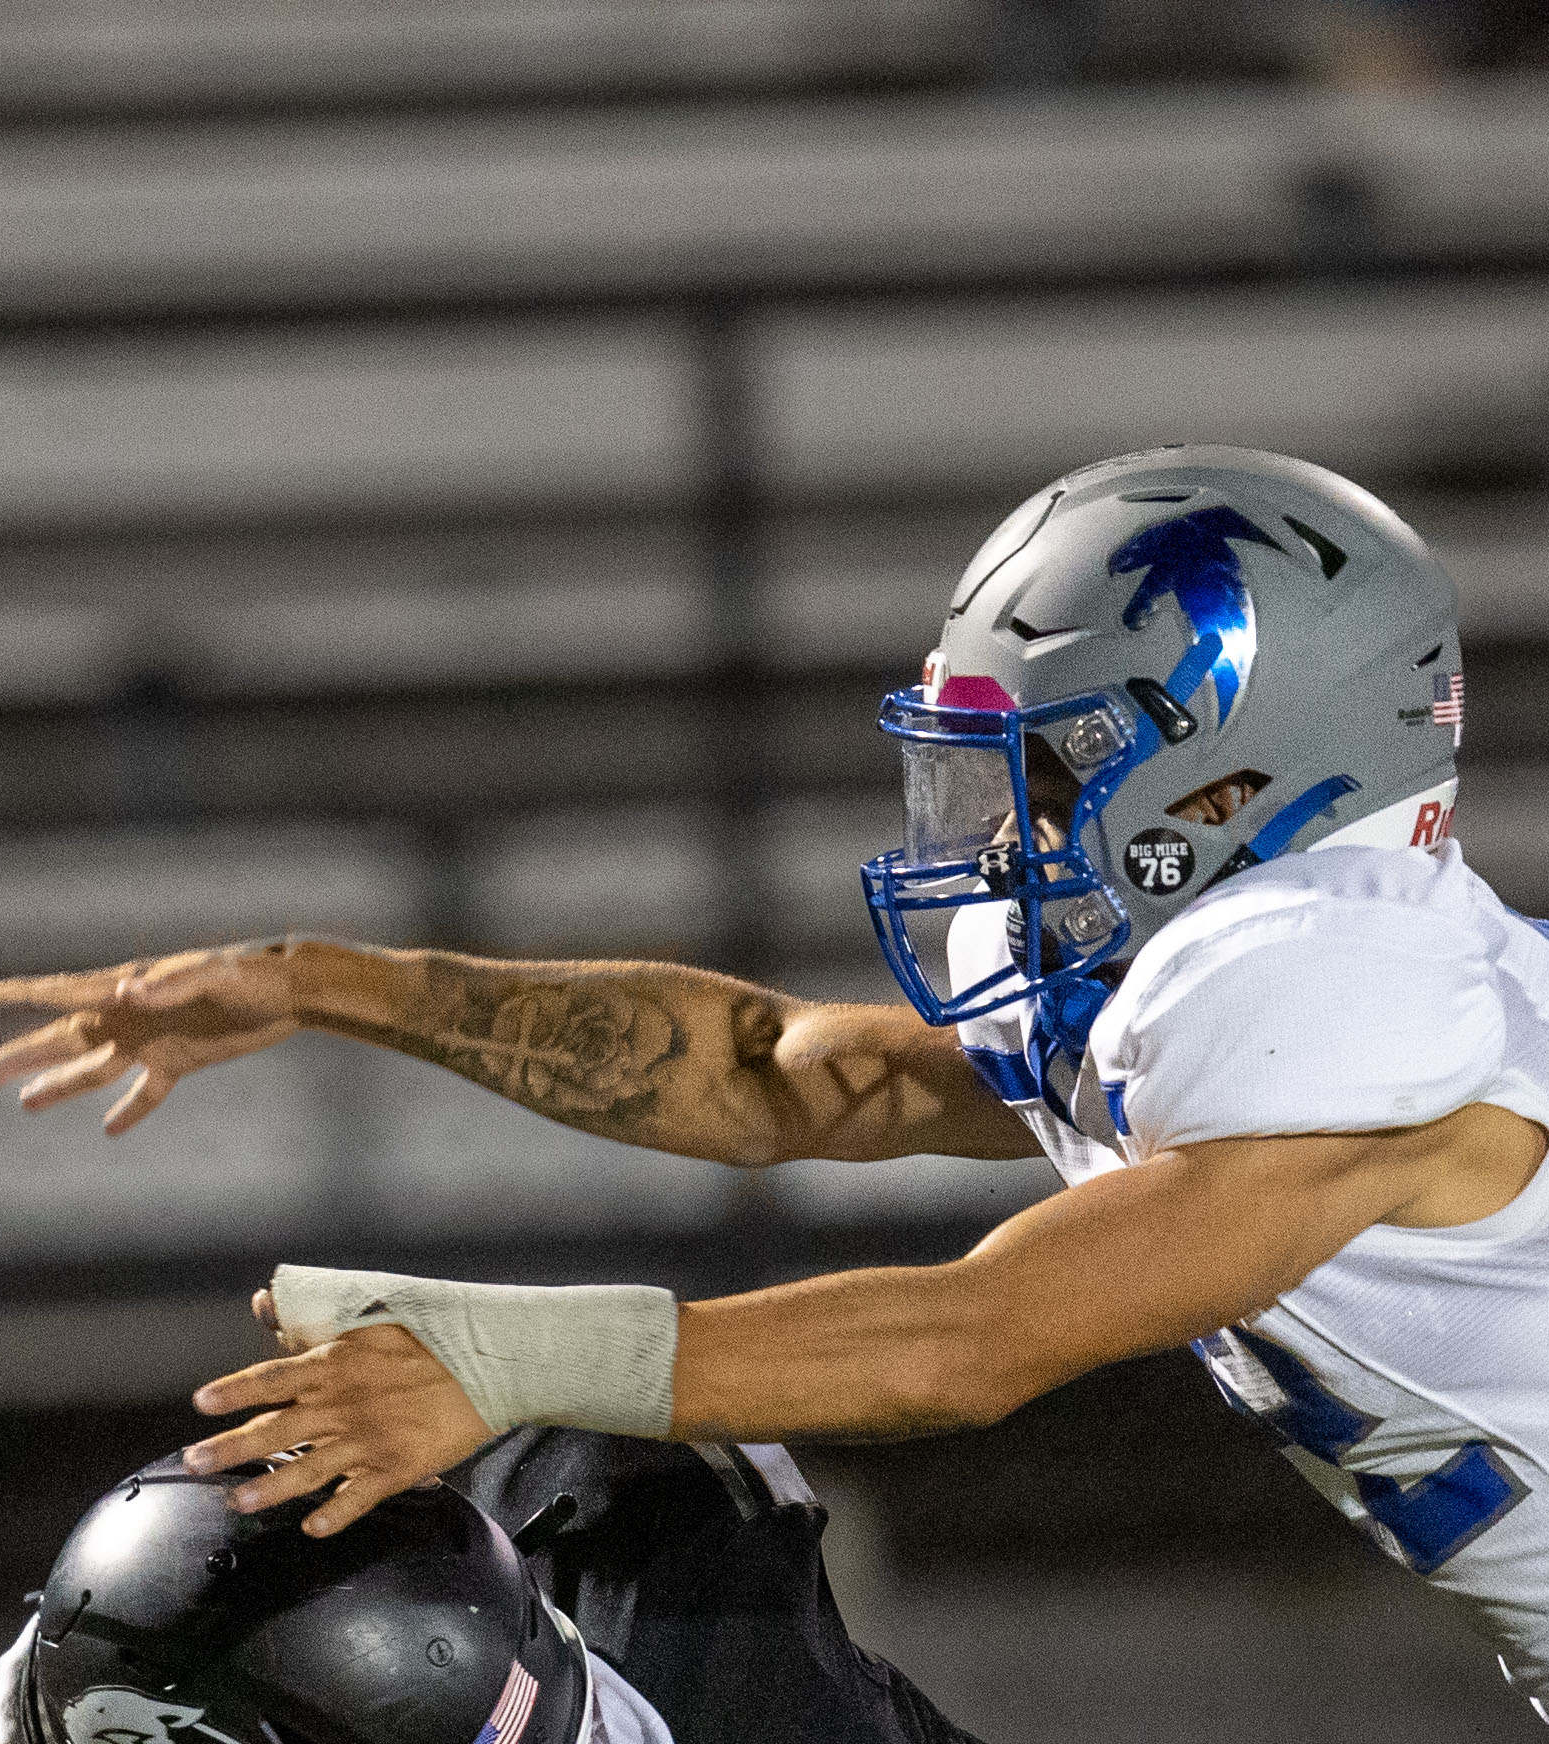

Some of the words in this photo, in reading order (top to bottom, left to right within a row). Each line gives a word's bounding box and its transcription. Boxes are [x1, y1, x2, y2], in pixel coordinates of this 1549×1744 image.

[1130, 844, 1152, 858] BIG
[1154, 842, 1189, 857] MIKE
[1139, 856, 1182, 888] 76
